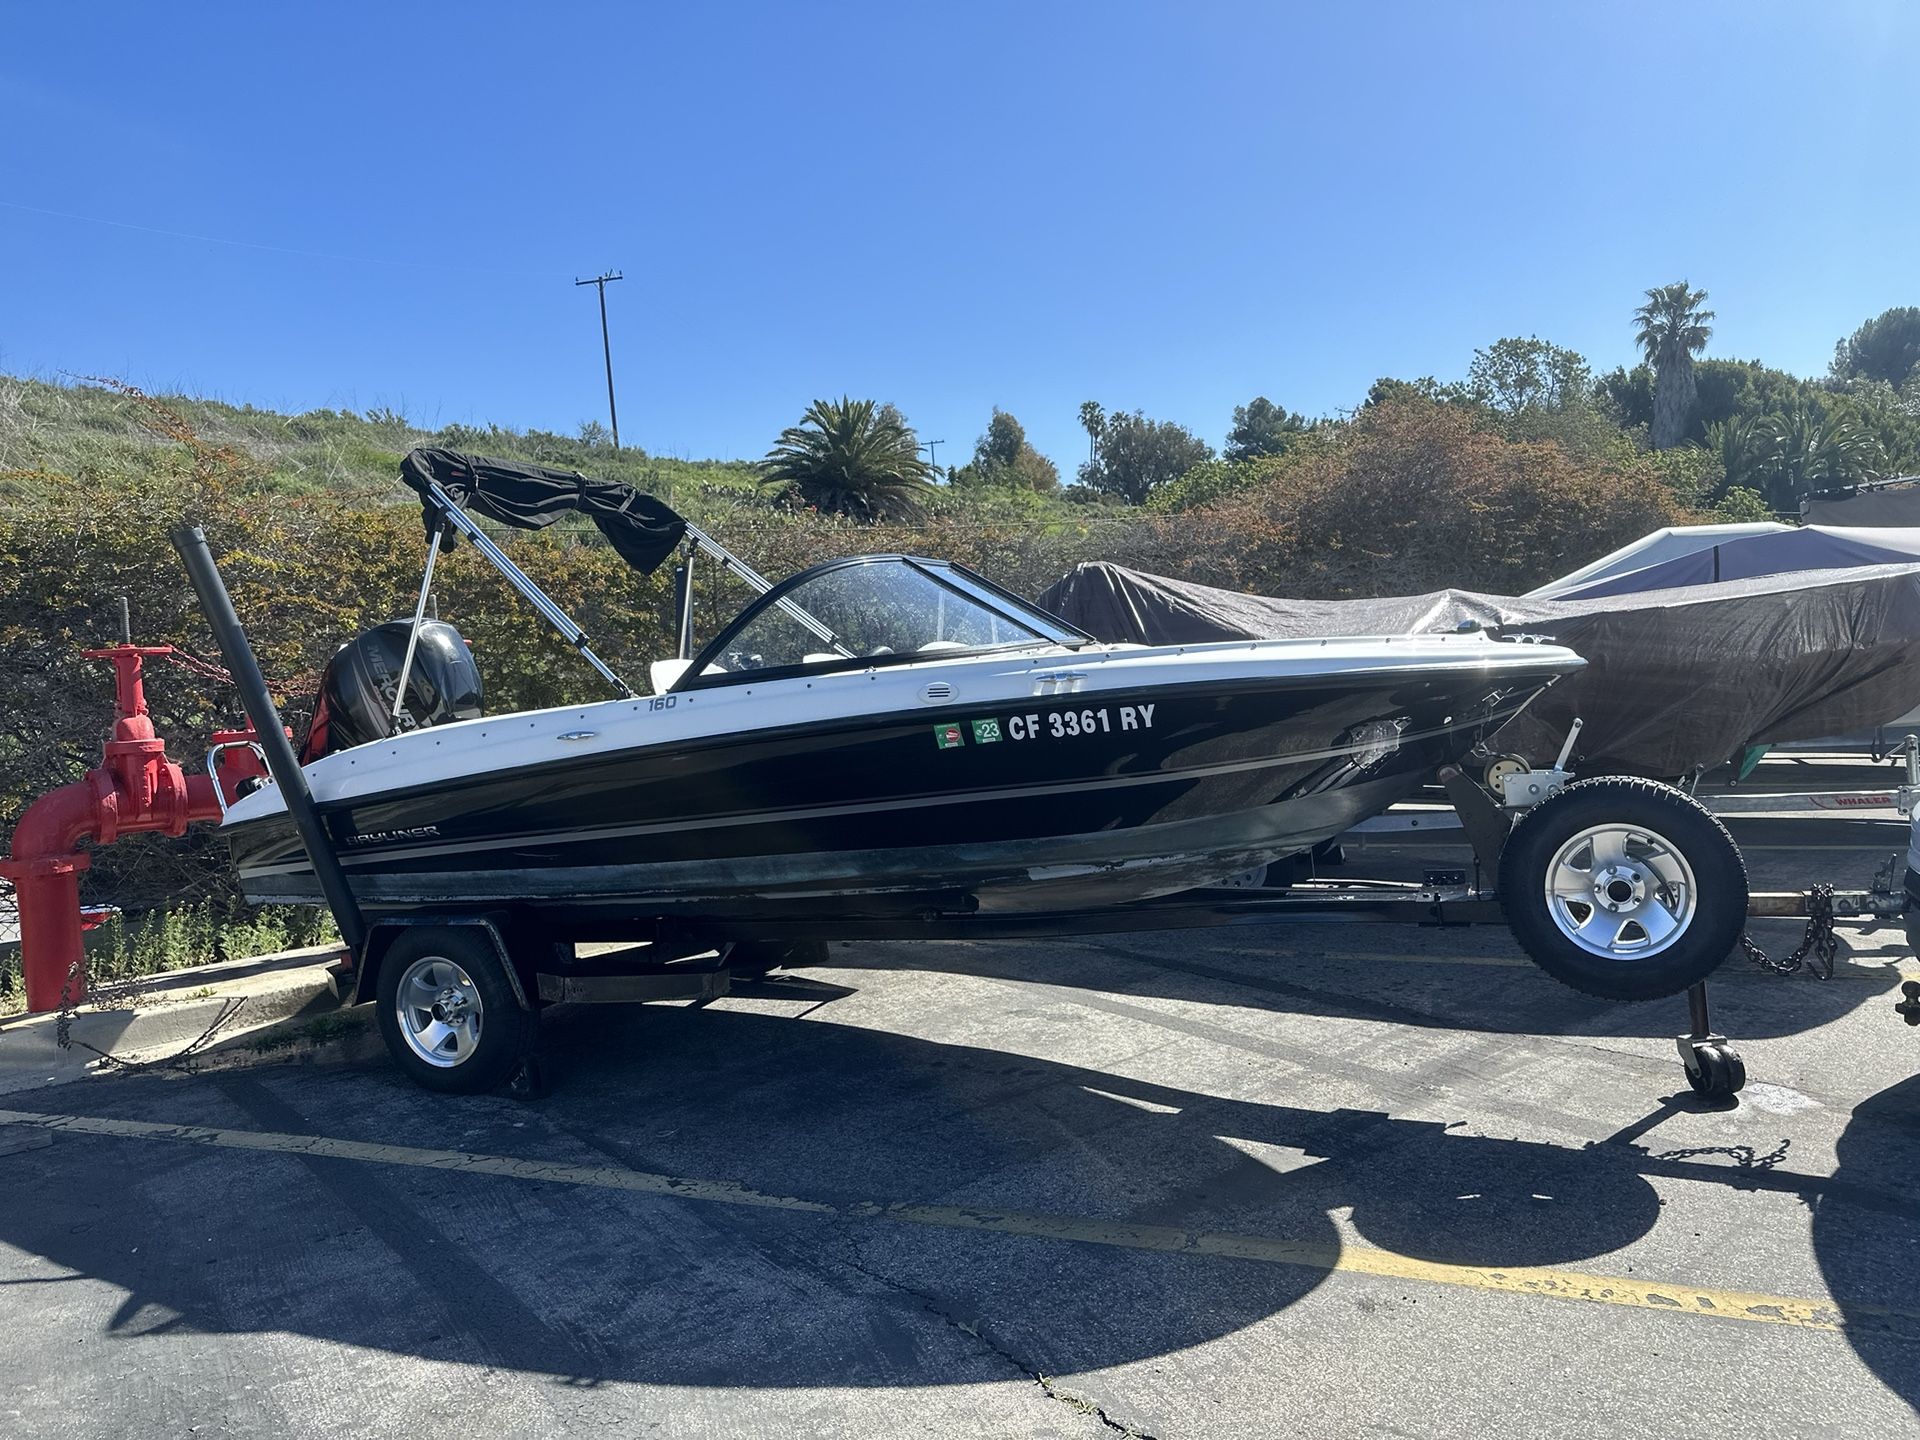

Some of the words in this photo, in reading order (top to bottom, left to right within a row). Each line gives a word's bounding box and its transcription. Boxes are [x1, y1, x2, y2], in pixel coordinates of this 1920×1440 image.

[368, 646, 419, 731] MERCR
[649, 696, 677, 712] 160
[1008, 714, 1040, 740] CF
[1049, 709, 1110, 737] 3361
[1120, 704, 1155, 731] RY
[981, 723, 1000, 738] 23
[1835, 797, 1892, 806] WHALER
